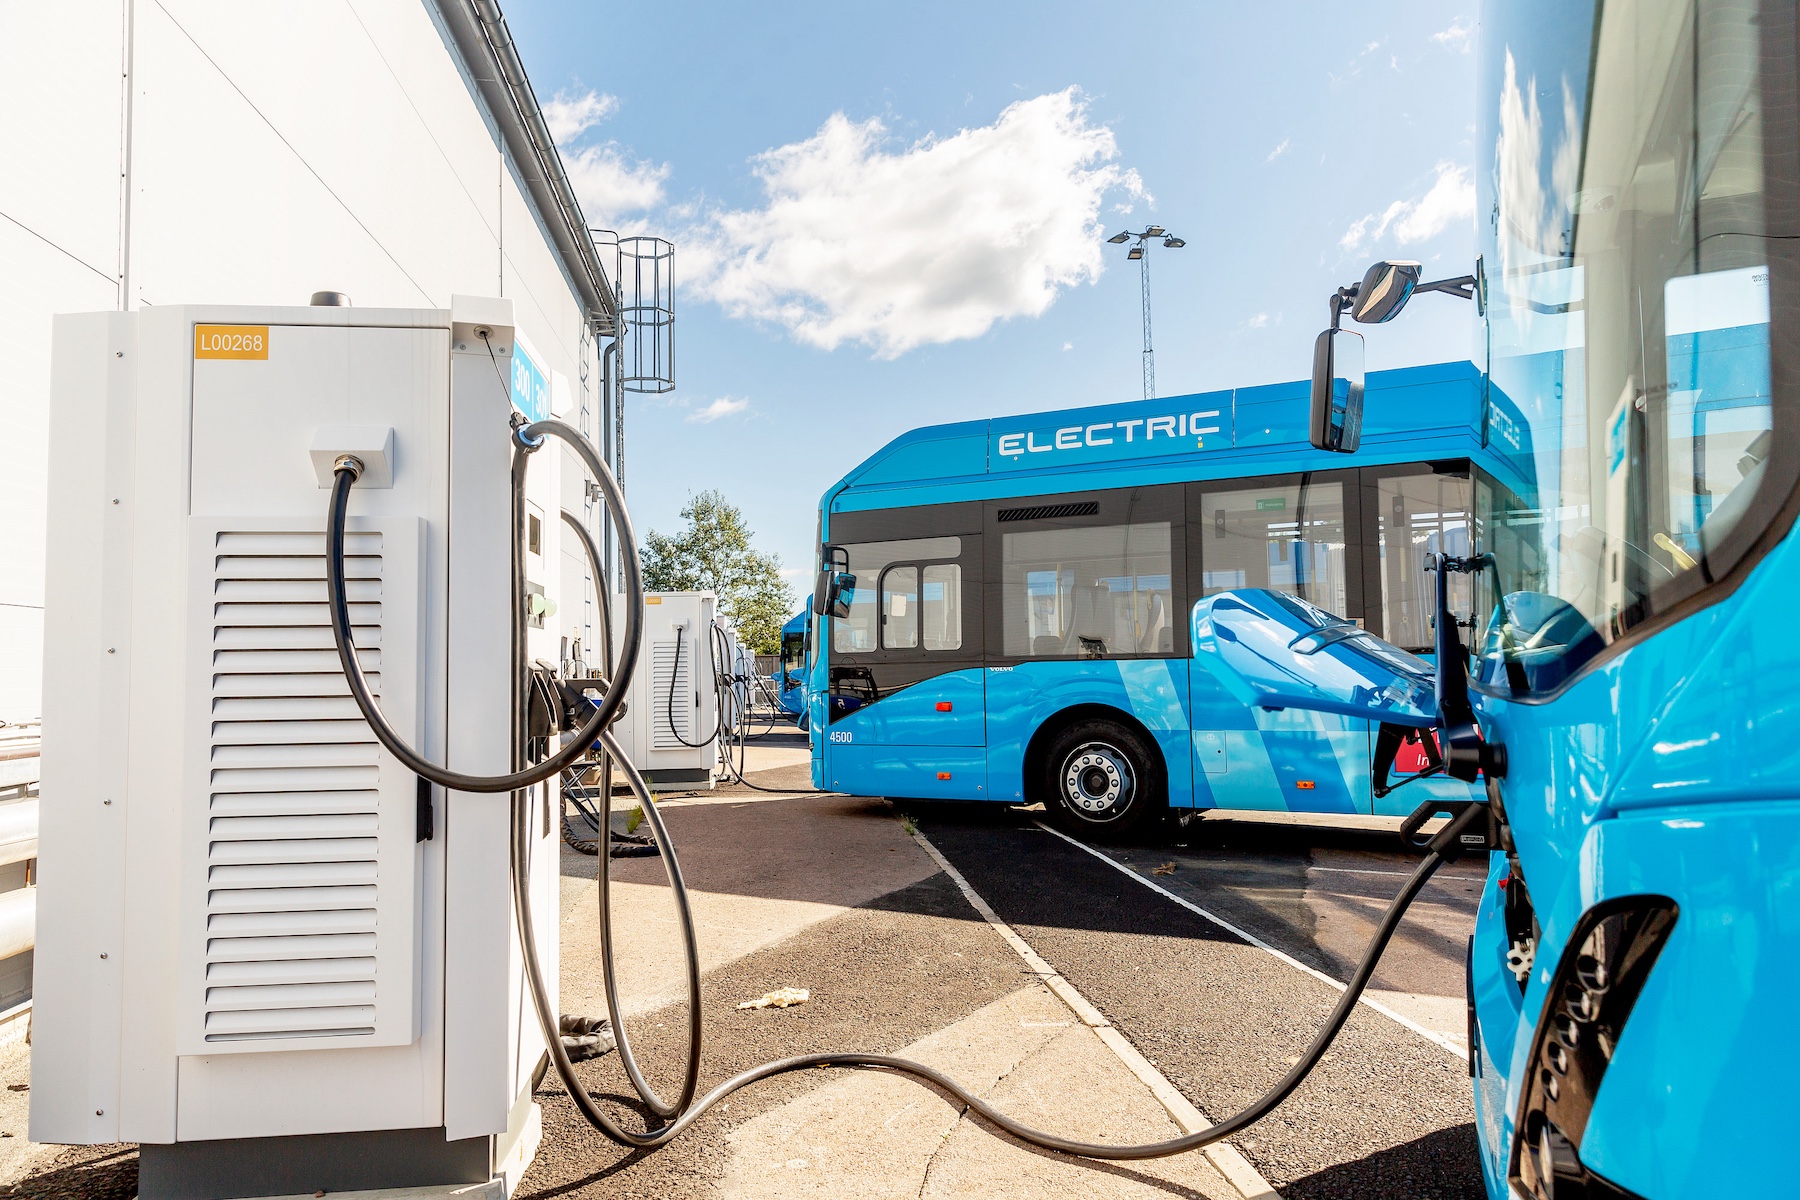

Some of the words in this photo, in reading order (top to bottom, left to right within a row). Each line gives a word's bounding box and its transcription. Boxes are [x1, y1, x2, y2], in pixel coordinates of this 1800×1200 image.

[201, 334, 263, 352] L00268
[516, 358, 530, 402] 300
[998, 410, 1220, 456] ELECTRIC
[829, 731, 853, 743] 4500
